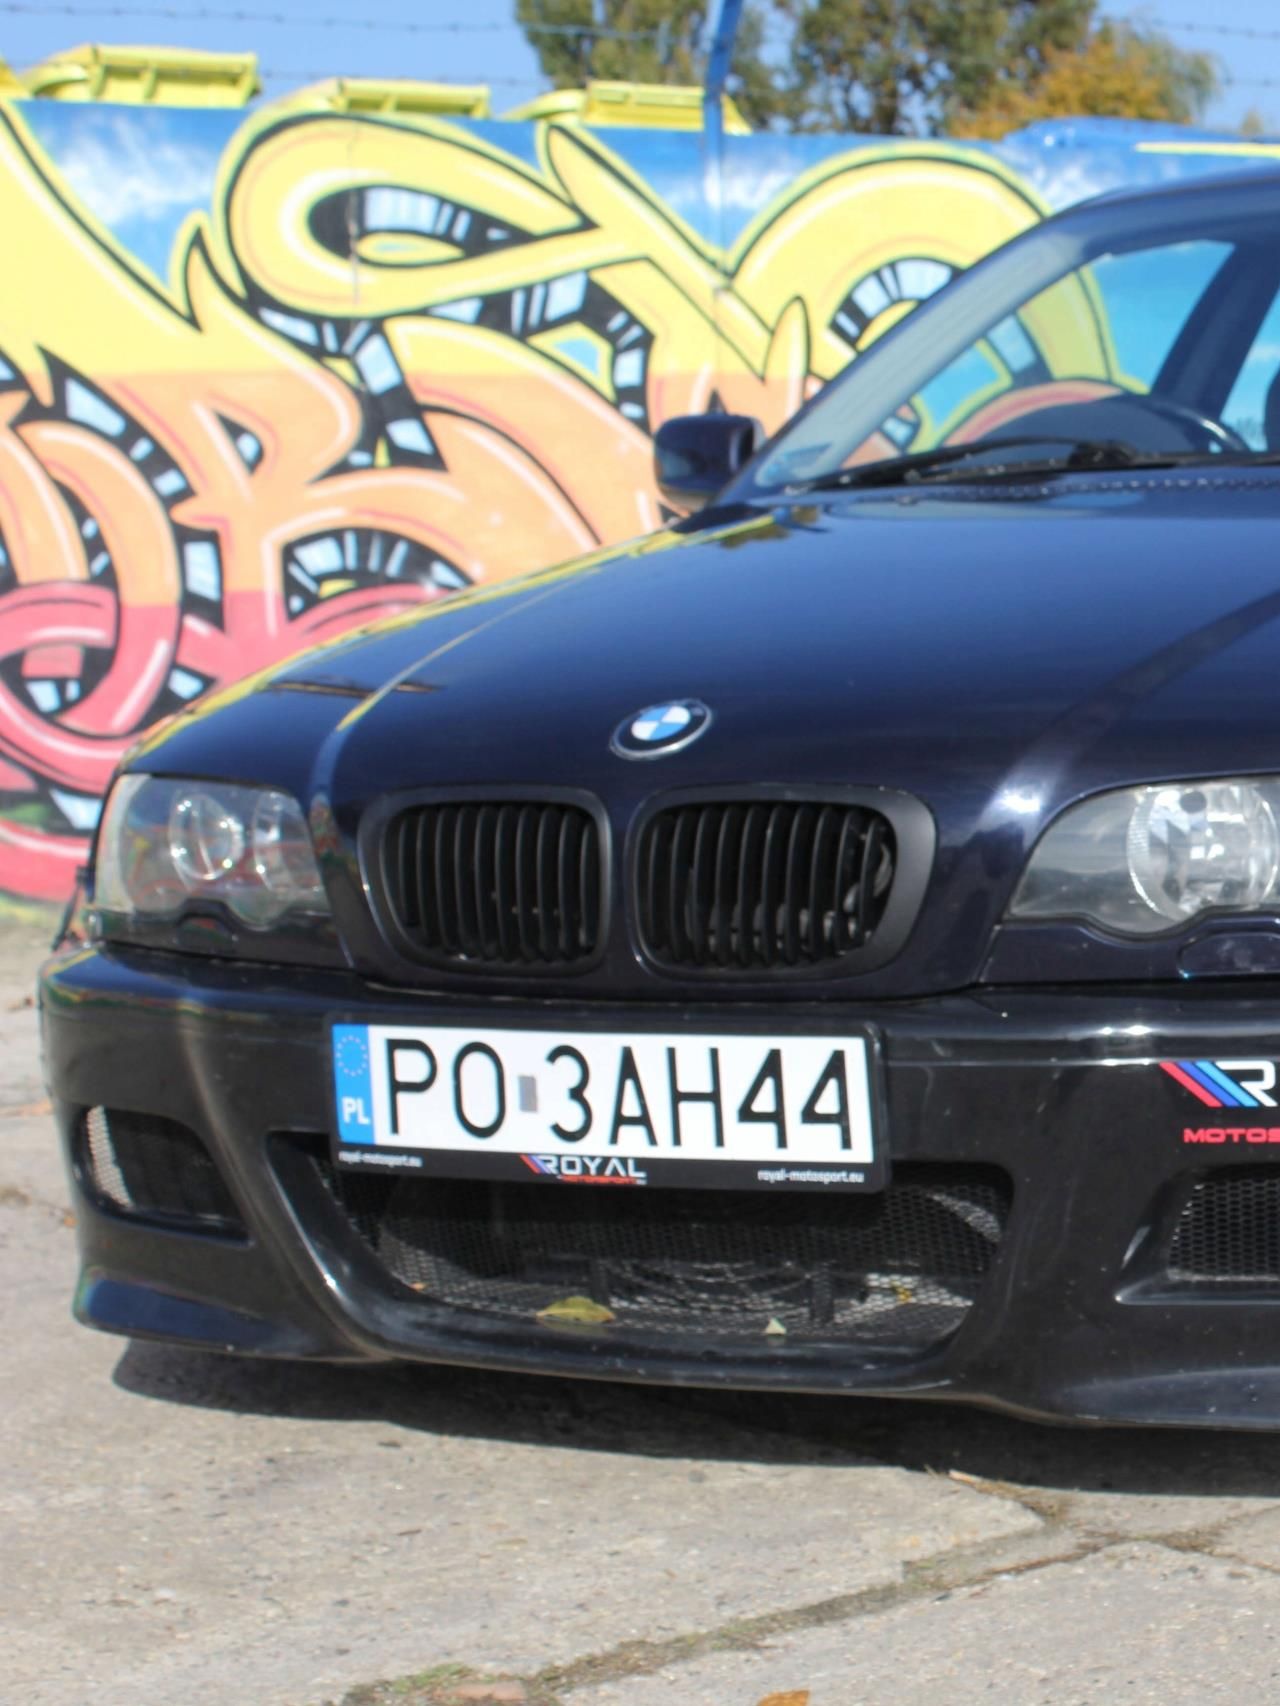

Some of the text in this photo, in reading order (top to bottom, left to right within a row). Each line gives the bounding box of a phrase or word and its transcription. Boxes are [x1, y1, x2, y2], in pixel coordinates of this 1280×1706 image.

[386, 1038, 854, 1151] PO 3AH44
[342, 1097, 371, 1125] PL
[536, 1153, 648, 1178] ROYAL
